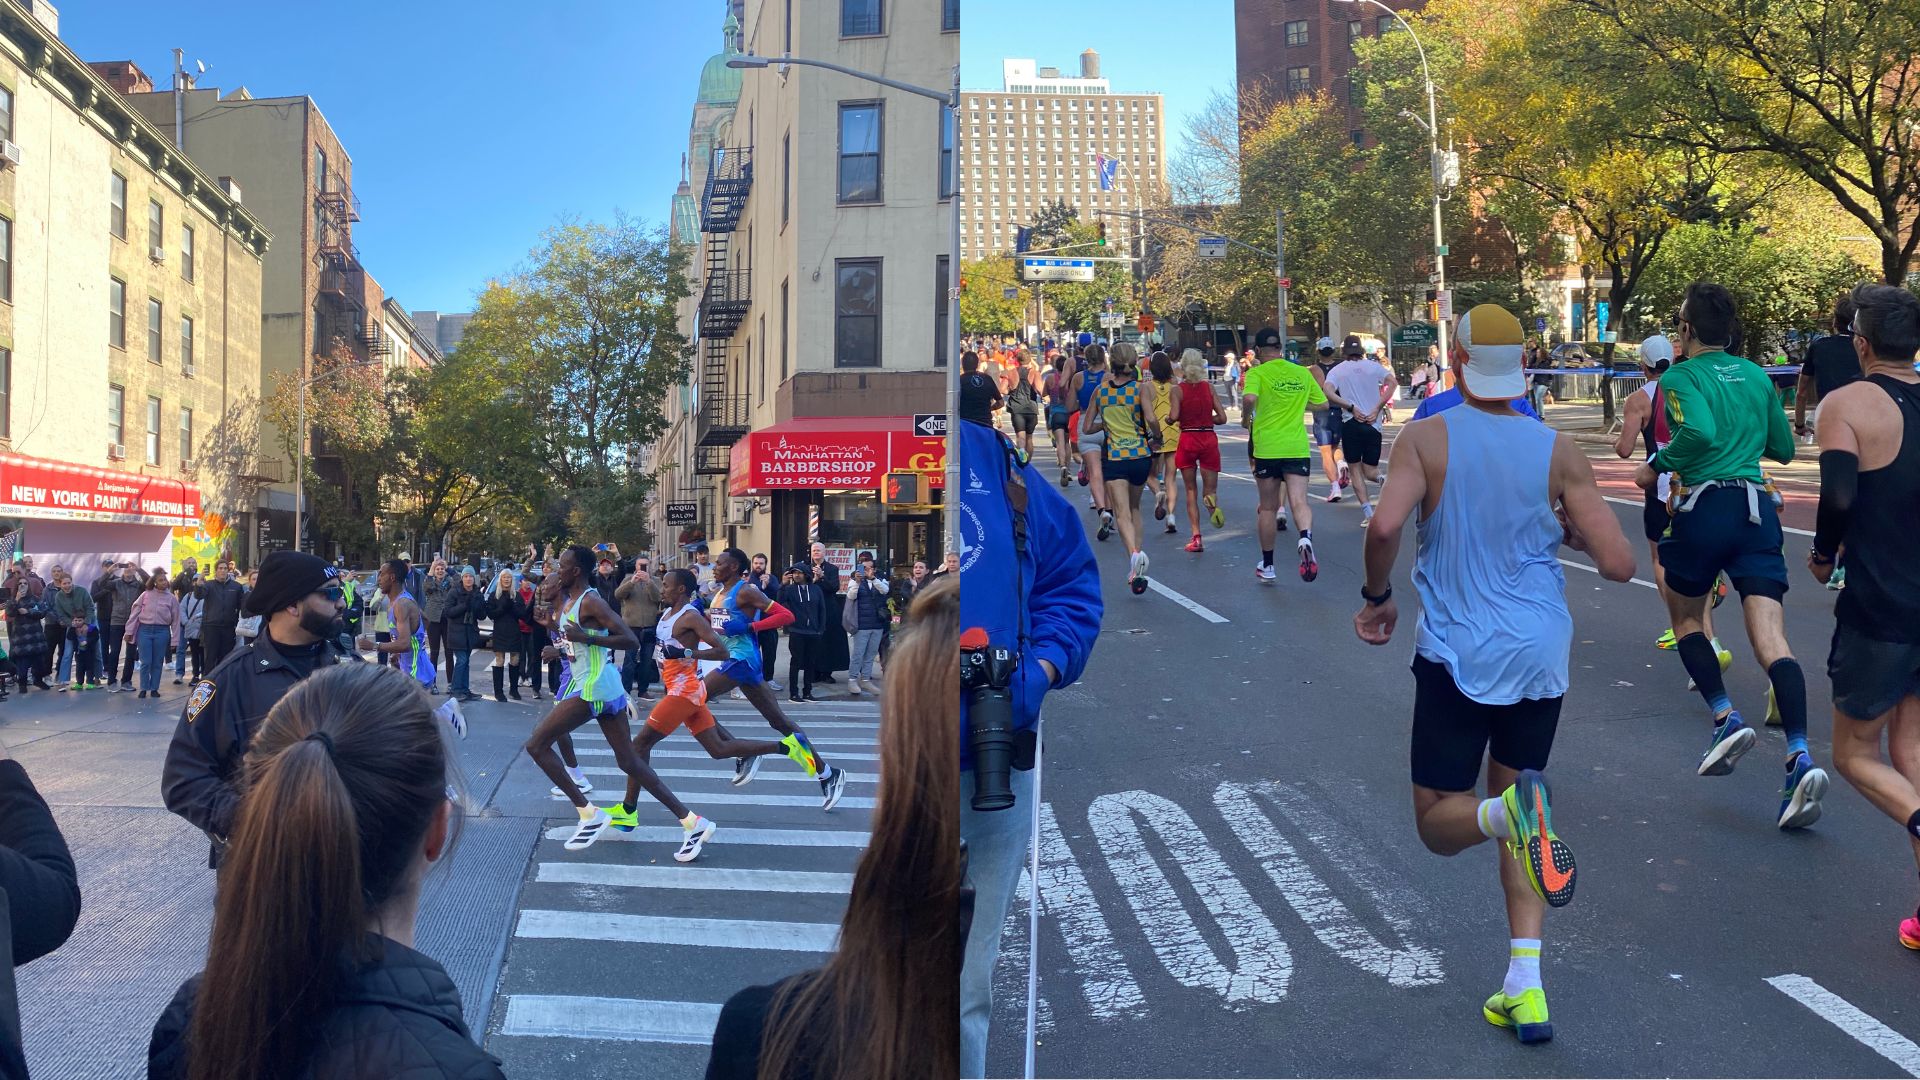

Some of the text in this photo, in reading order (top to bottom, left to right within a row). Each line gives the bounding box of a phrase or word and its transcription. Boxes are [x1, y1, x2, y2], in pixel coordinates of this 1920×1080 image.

[926, 421, 946, 430] ONE
[774, 450, 863, 460] MANHATTAN
[761, 462, 876, 473] BARBERSHOP
[765, 477, 871, 485] 212-876-9627
[104, 482, 140, 494] Benjamin Moore
[11, 485, 195, 516] NEW YORK PAINT & HARDWARE
